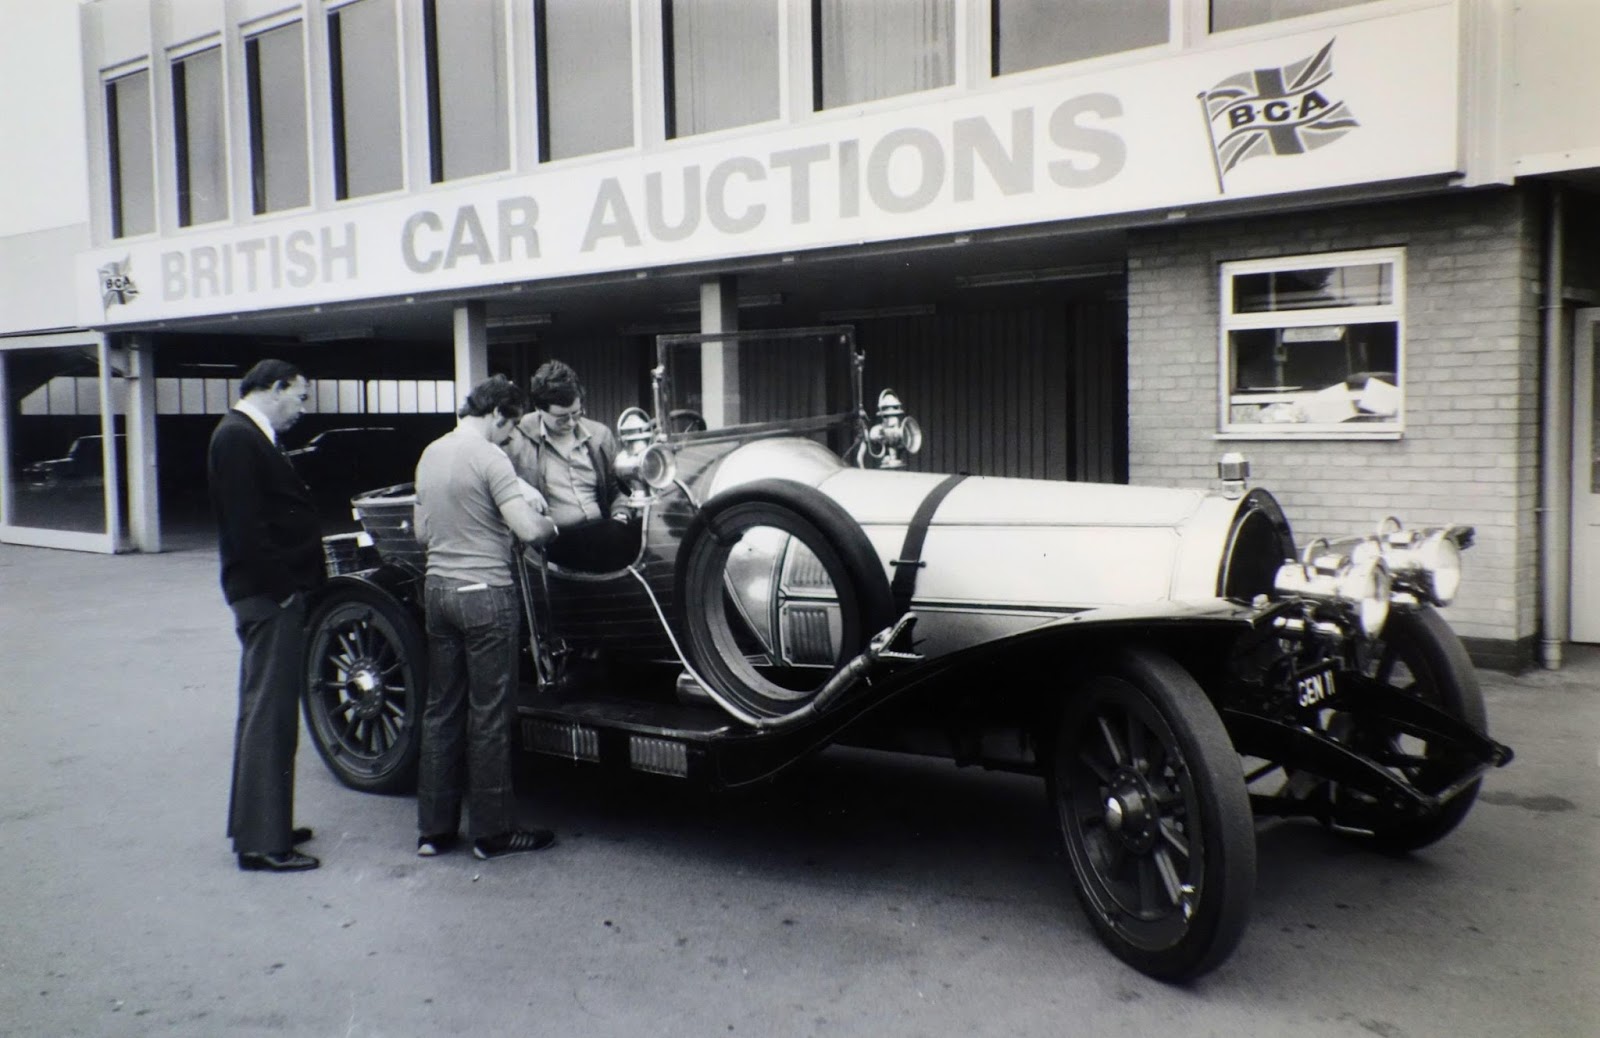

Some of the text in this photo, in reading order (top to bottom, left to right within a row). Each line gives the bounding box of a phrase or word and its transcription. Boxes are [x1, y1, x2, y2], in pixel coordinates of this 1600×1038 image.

[161, 93, 1127, 301] BRITISH CAR AUCTIONS
